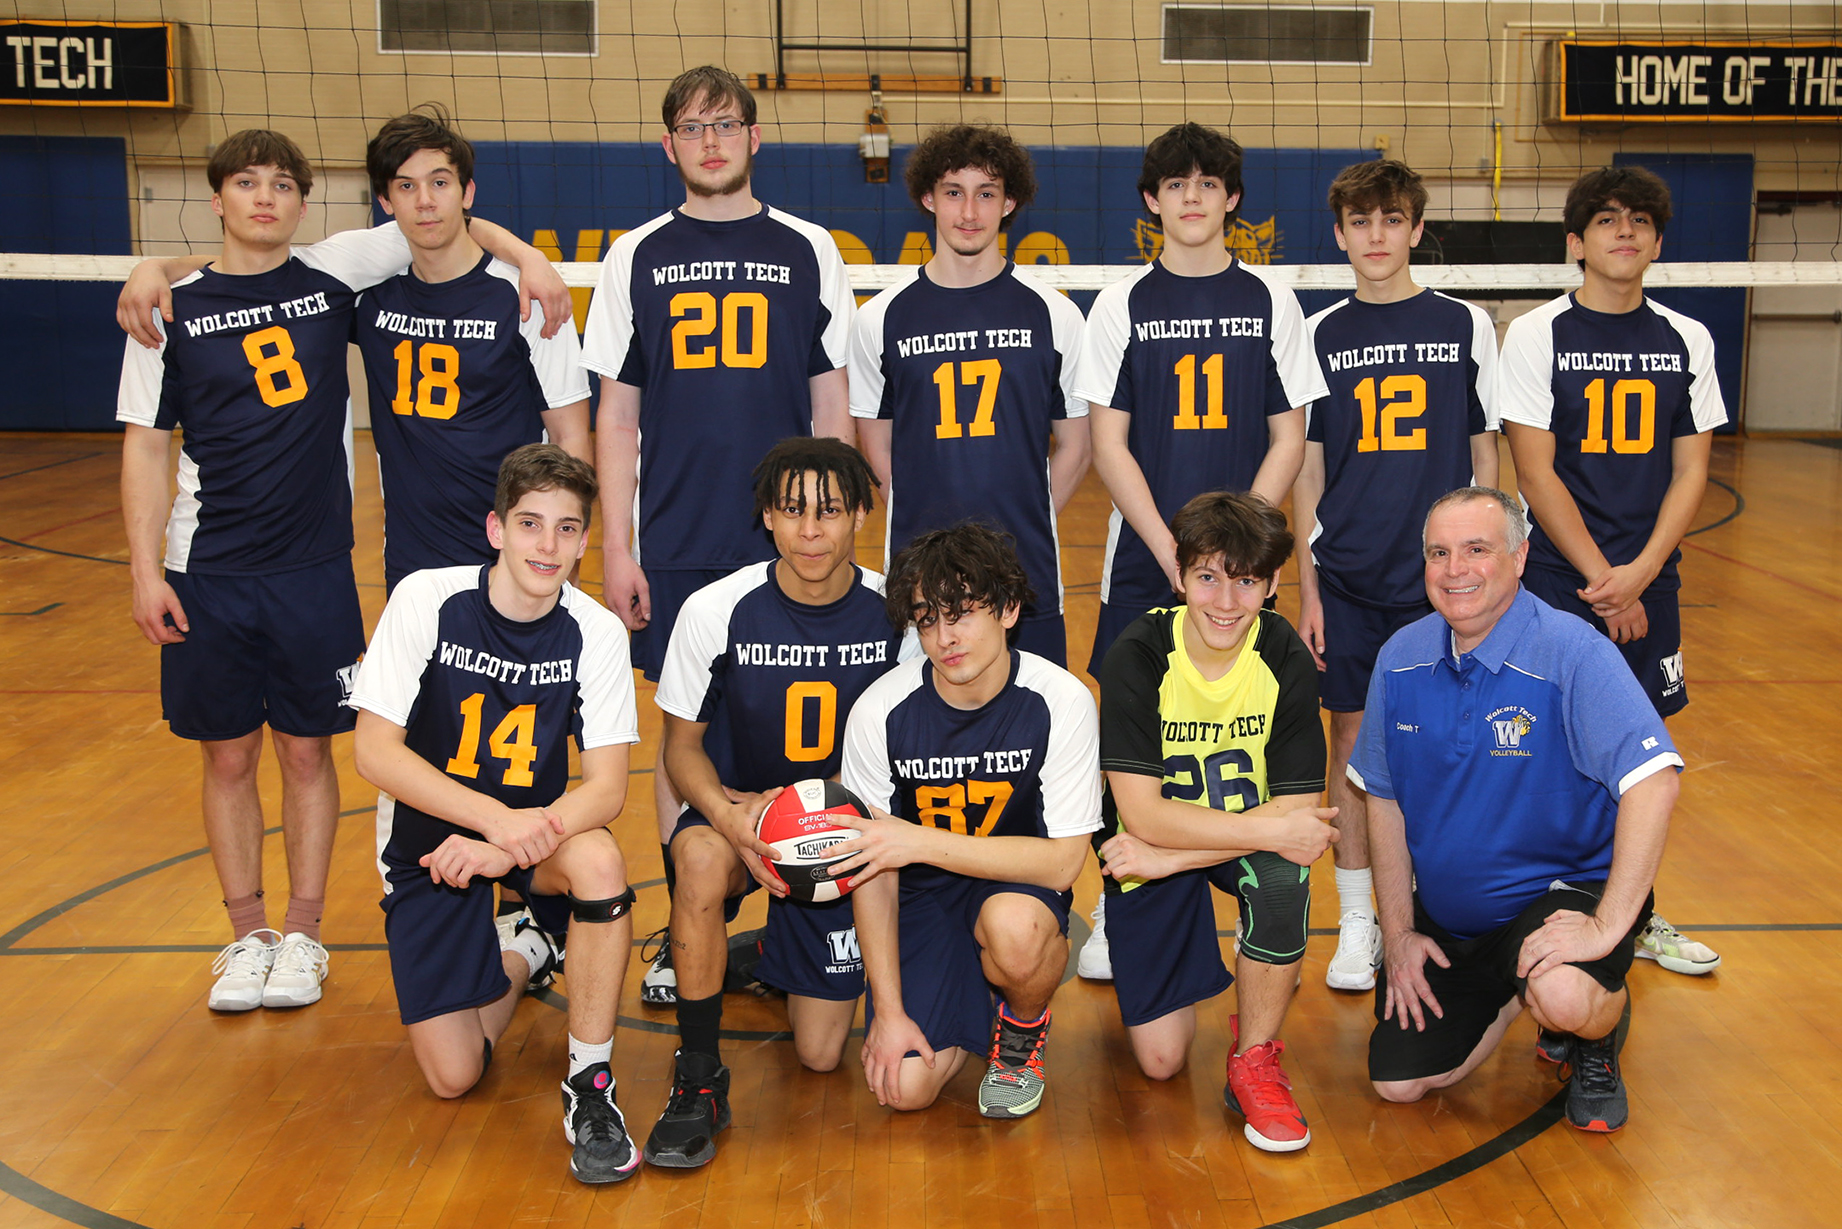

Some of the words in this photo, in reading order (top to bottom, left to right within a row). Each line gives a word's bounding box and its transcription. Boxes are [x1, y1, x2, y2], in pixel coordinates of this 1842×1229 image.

[7, 36, 112, 90] TECH
[1616, 55, 1713, 104] HOME
[1722, 56, 1771, 105] OF
[653, 261, 736, 285] WOLCOTT
[744, 261, 790, 285] TECH
[185, 304, 273, 337] WOLCOTT
[280, 291, 330, 319] TECH
[375, 310, 446, 339] WOLCOTT
[453, 319, 498, 340] TECH
[670, 292, 768, 369] 20
[1135, 319, 1212, 341] WOLCOTT
[1218, 317, 1264, 338] TECH
[242, 326, 308, 407] 8
[897, 330, 978, 359] WOLCOTT
[985, 328, 1032, 349] TECH
[1327, 343, 1407, 373] WOLCOTT
[1414, 342, 1460, 363] TECH
[1557, 353, 1633, 372] WOLCOTT
[1639, 353, 1682, 373] TECH
[392, 340, 460, 419] 18
[933, 359, 1002, 439] 17
[1174, 354, 1227, 430] 11
[1354, 375, 1427, 453] 12
[1580, 379, 1656, 454] 10
[440, 641, 526, 685] WOLCOTT
[530, 658, 573, 686] TECH
[736, 643, 829, 667] WOLCOTT
[838, 640, 888, 666] TECH
[784, 681, 838, 762] 0
[1396, 722, 1413, 732] Coach
[1414, 725, 1420, 733] T
[1485, 705, 1518, 722] Wolcott
[1518, 706, 1537, 722] Tech
[445, 692, 537, 788] 14
[1489, 749, 1533, 757] VOLLEYBALL
[894, 756, 979, 780] WOLCOTT
[1161, 749, 1260, 813] 26
[915, 779, 1014, 837] 87
[825, 965, 854, 974] WOLCOTT
